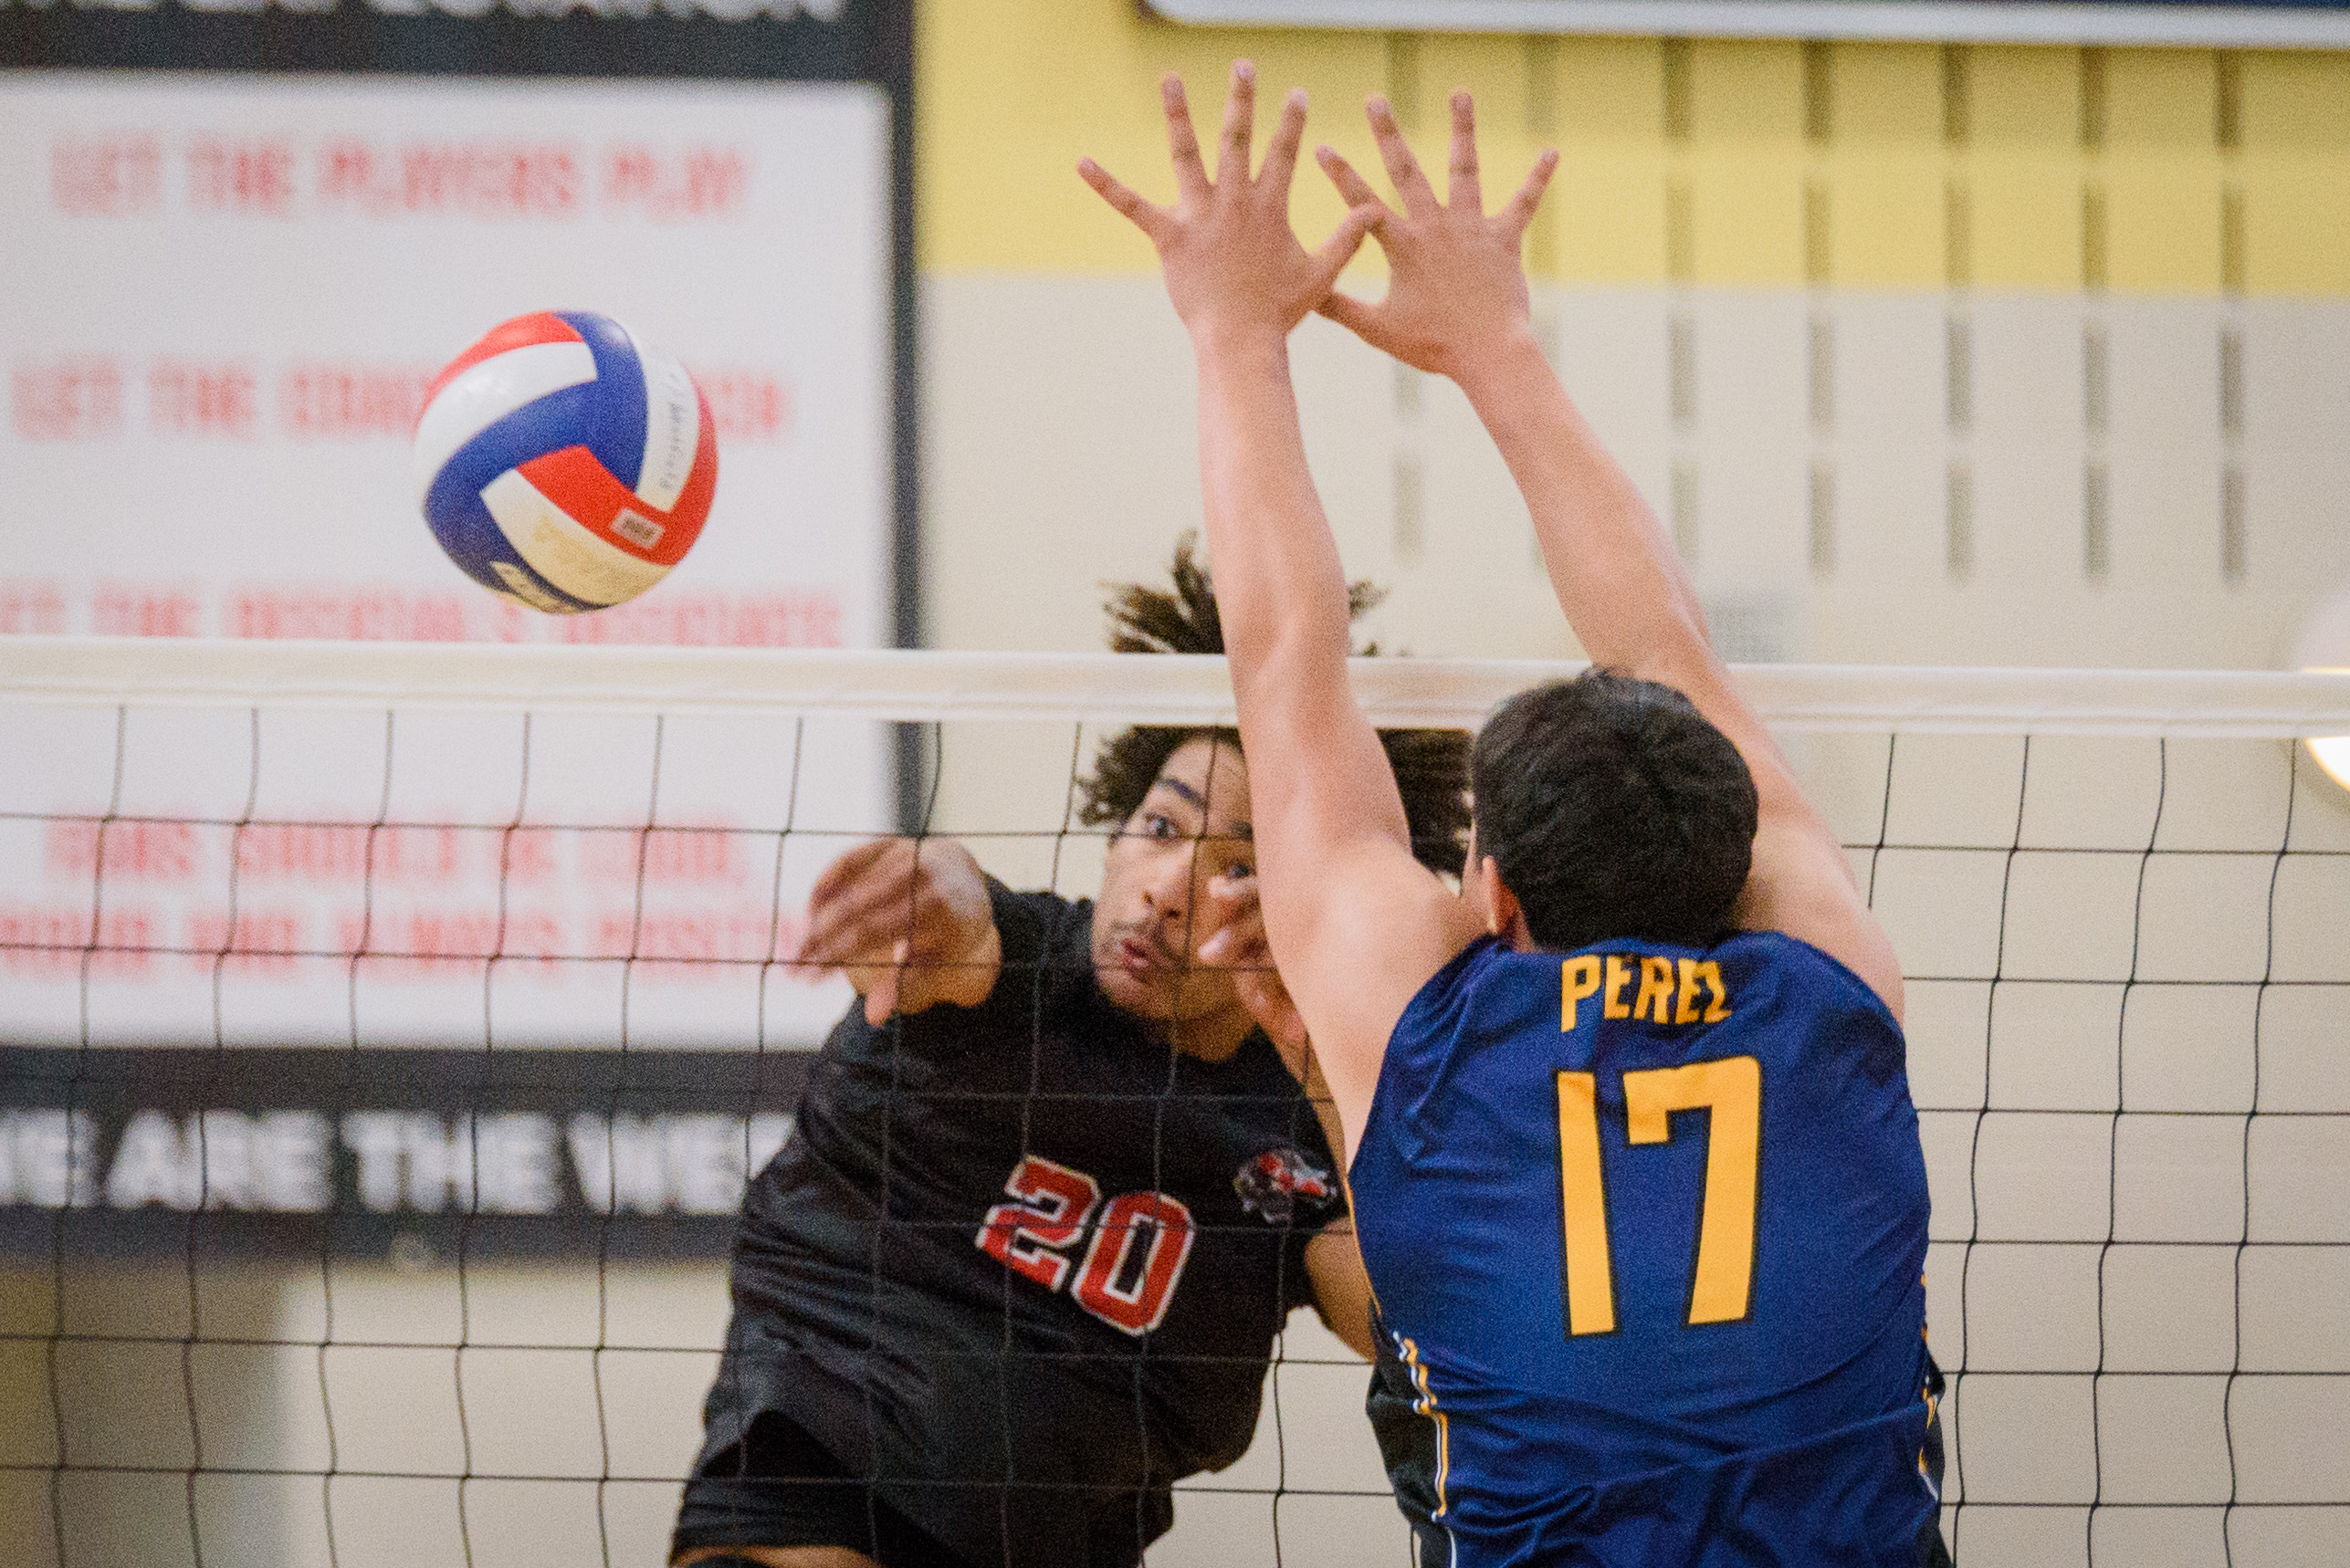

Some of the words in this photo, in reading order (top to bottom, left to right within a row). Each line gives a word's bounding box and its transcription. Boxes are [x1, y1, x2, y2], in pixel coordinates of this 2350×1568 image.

[1560, 954, 1733, 1033] PEREZ
[105, 1109, 334, 1213] ARE
[341, 1111, 558, 1214] THE
[1556, 1053, 1761, 1338] 17
[974, 1154, 1196, 1336] 20
